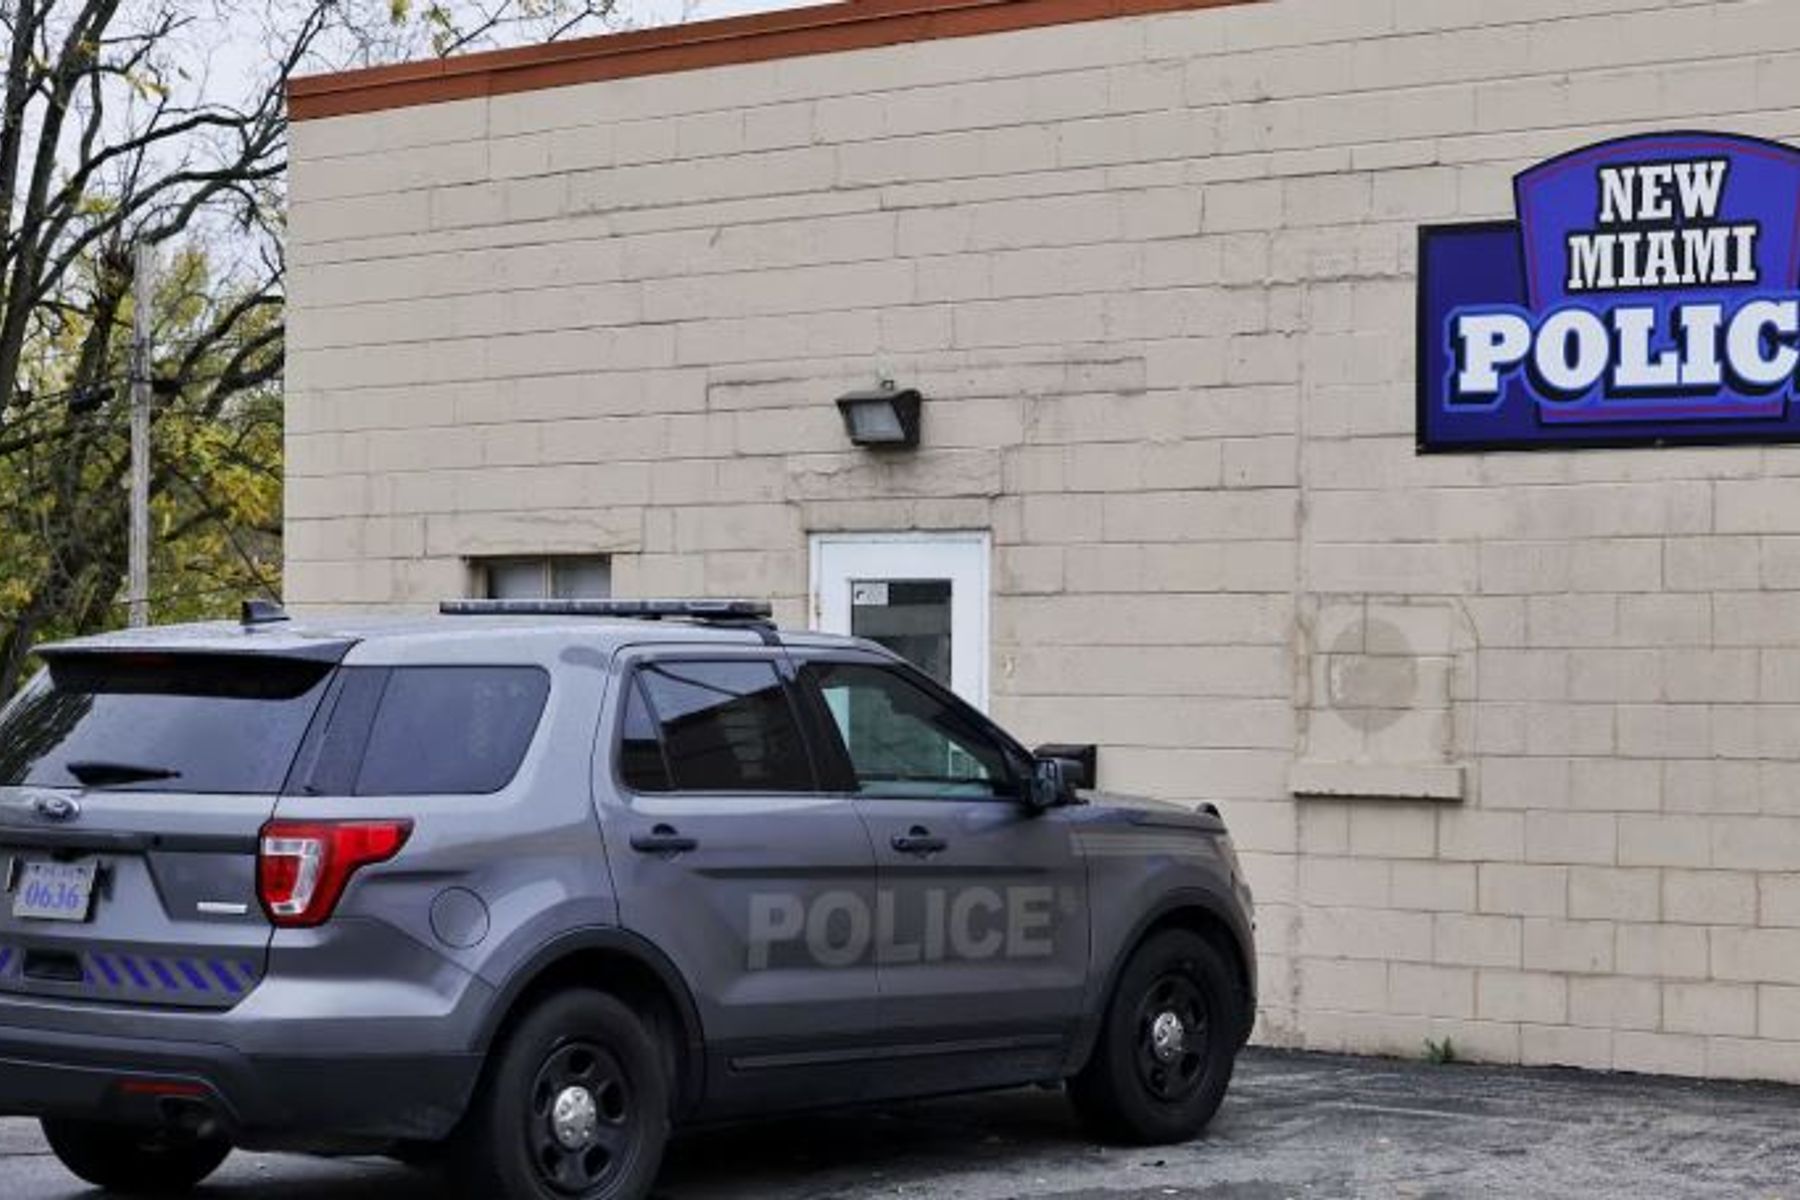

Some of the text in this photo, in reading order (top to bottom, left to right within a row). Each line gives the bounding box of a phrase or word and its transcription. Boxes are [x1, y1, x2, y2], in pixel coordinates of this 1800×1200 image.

[1599, 160, 1727, 223] NEW
[1567, 226, 1757, 289] MIAMI
[1457, 300, 1800, 393] POLIC
[25, 881, 80, 910] 0636
[747, 886, 1055, 970] POLICE
